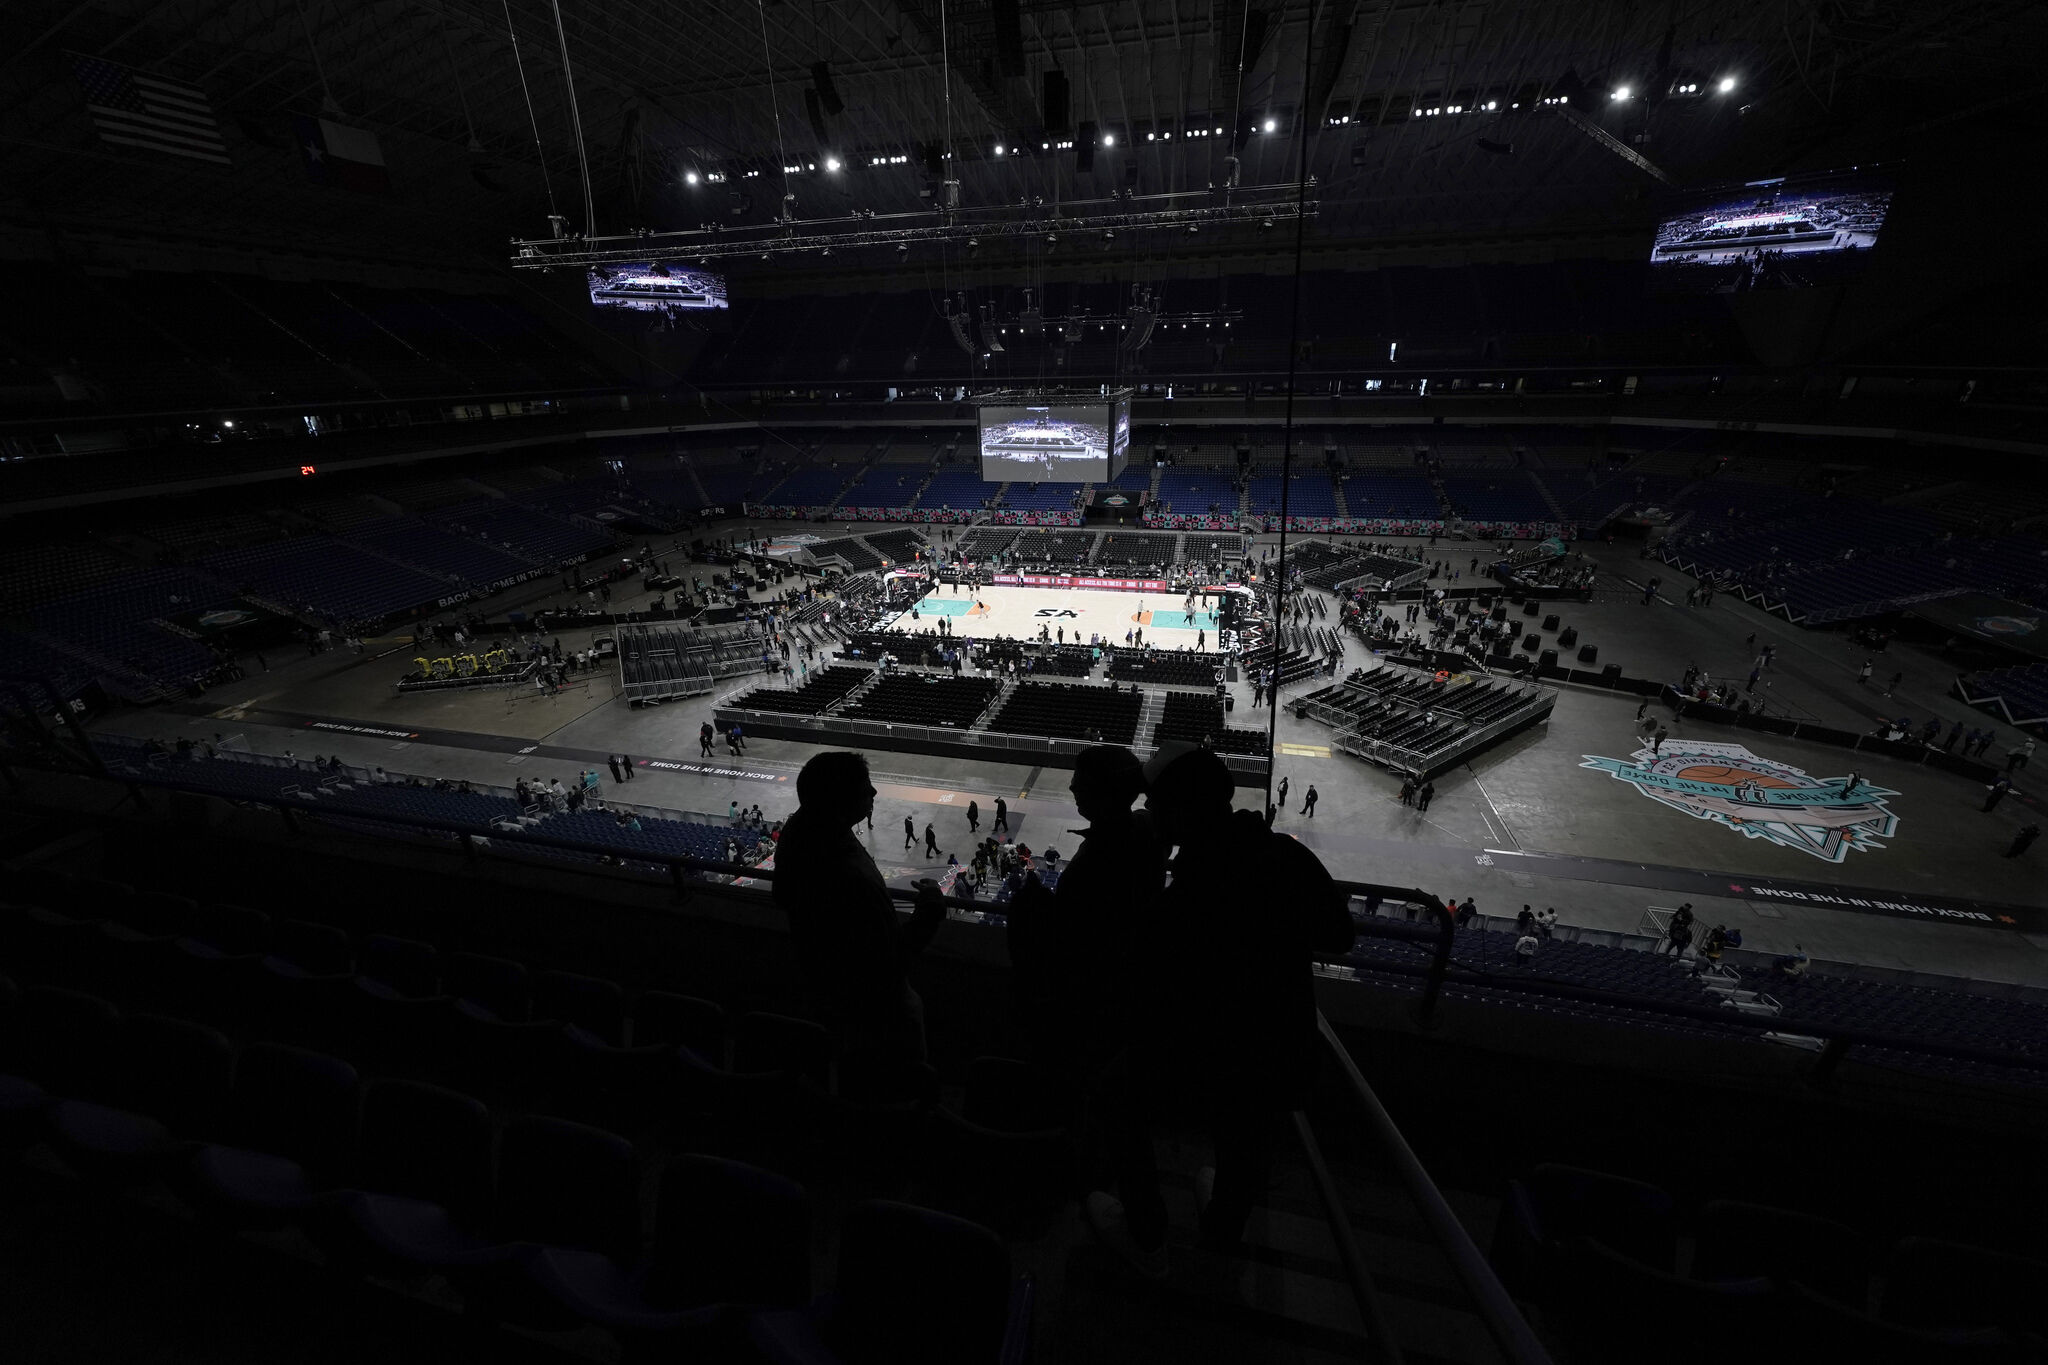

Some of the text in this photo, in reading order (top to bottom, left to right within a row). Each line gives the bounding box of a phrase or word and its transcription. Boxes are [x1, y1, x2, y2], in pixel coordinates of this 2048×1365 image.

[301, 466, 315, 475] 24
[438, 591, 470, 607] BACK
[516, 572, 528, 582] IN
[561, 554, 588, 568] DOME
[650, 761, 681, 769] DOME
[681, 764, 701, 772] THE
[1679, 758, 1743, 769] ANTONIO
[713, 768, 745, 778] HOME
[745, 772, 775, 780] BACK
[1624, 769, 1670, 786] DOME
[1750, 766, 1789, 779] SAN
[1675, 782, 1709, 793] THE
[1750, 887, 1993, 921] BACK HOME IN THE DOME
